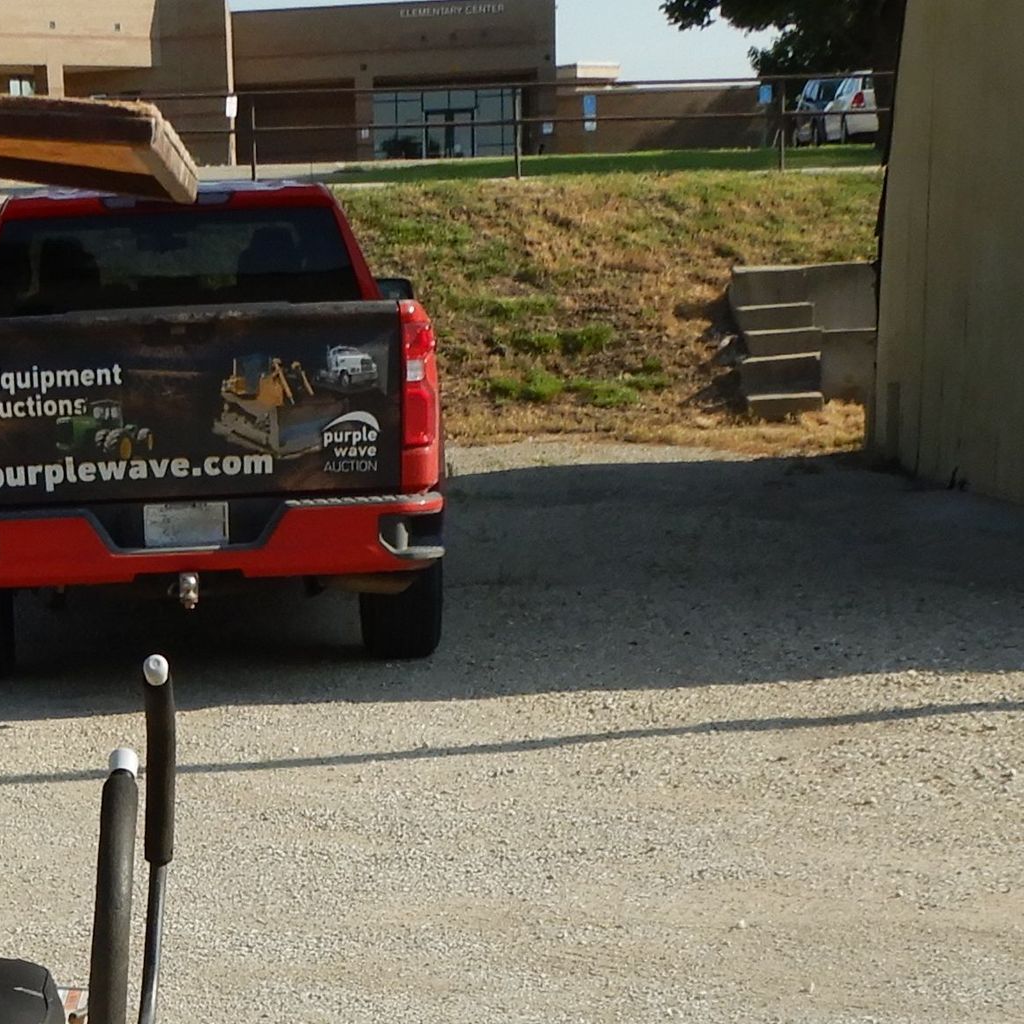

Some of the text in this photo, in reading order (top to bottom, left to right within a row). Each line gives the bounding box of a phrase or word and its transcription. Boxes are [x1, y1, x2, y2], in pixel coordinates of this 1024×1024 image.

[399, 3, 505, 18] ELEMENTARY CENTER
[323, 424, 378, 448] purple
[333, 445, 377, 457] wave
[323, 460, 378, 472] AUCTION
